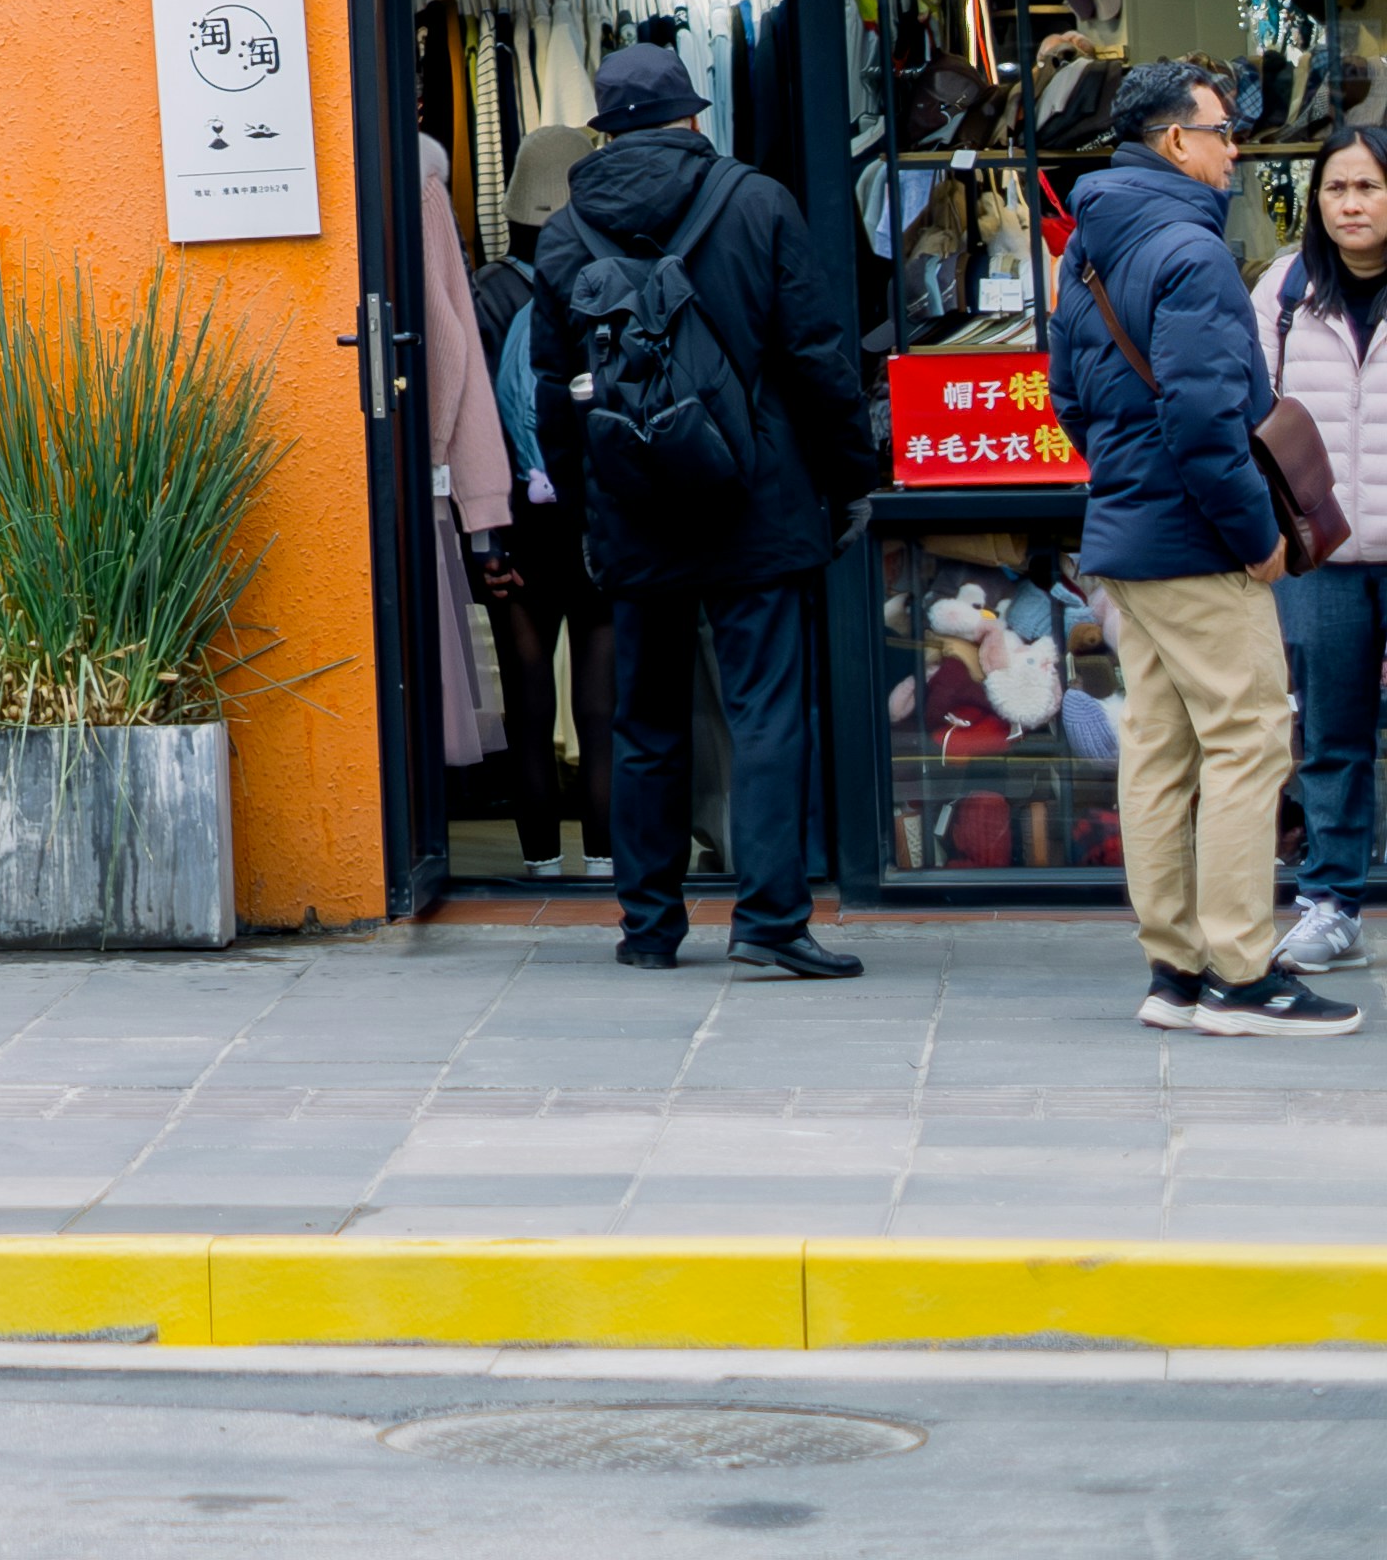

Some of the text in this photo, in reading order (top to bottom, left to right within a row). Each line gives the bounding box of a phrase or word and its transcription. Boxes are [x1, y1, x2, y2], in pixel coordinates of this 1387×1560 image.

[189, 17, 280, 75] 淘淘
[943, 370, 1050, 411] 帽子特
[905, 424, 1073, 464] 羊毛大衣特
